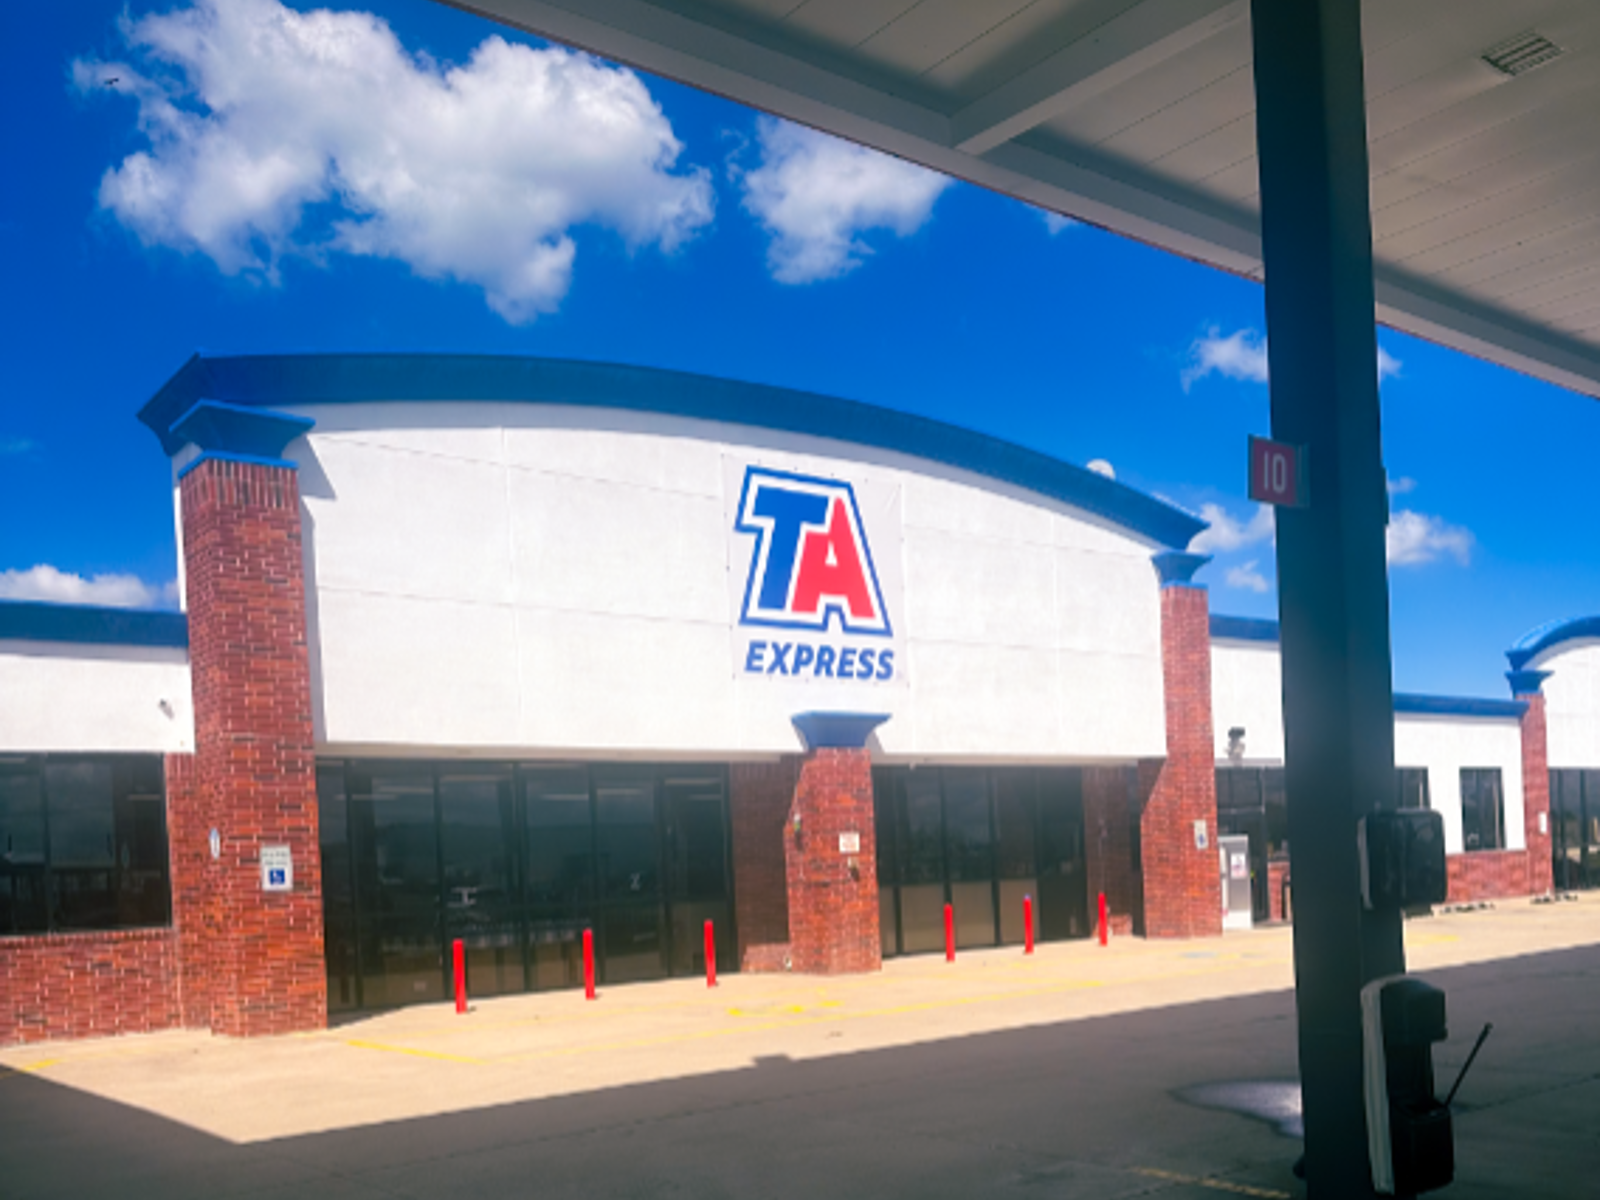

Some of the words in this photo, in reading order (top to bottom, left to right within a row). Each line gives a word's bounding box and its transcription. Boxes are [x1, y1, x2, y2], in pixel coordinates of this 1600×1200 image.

[1264, 451, 1287, 494] 10
[735, 465, 893, 637] TA
[744, 640, 894, 681] EXPRESS
